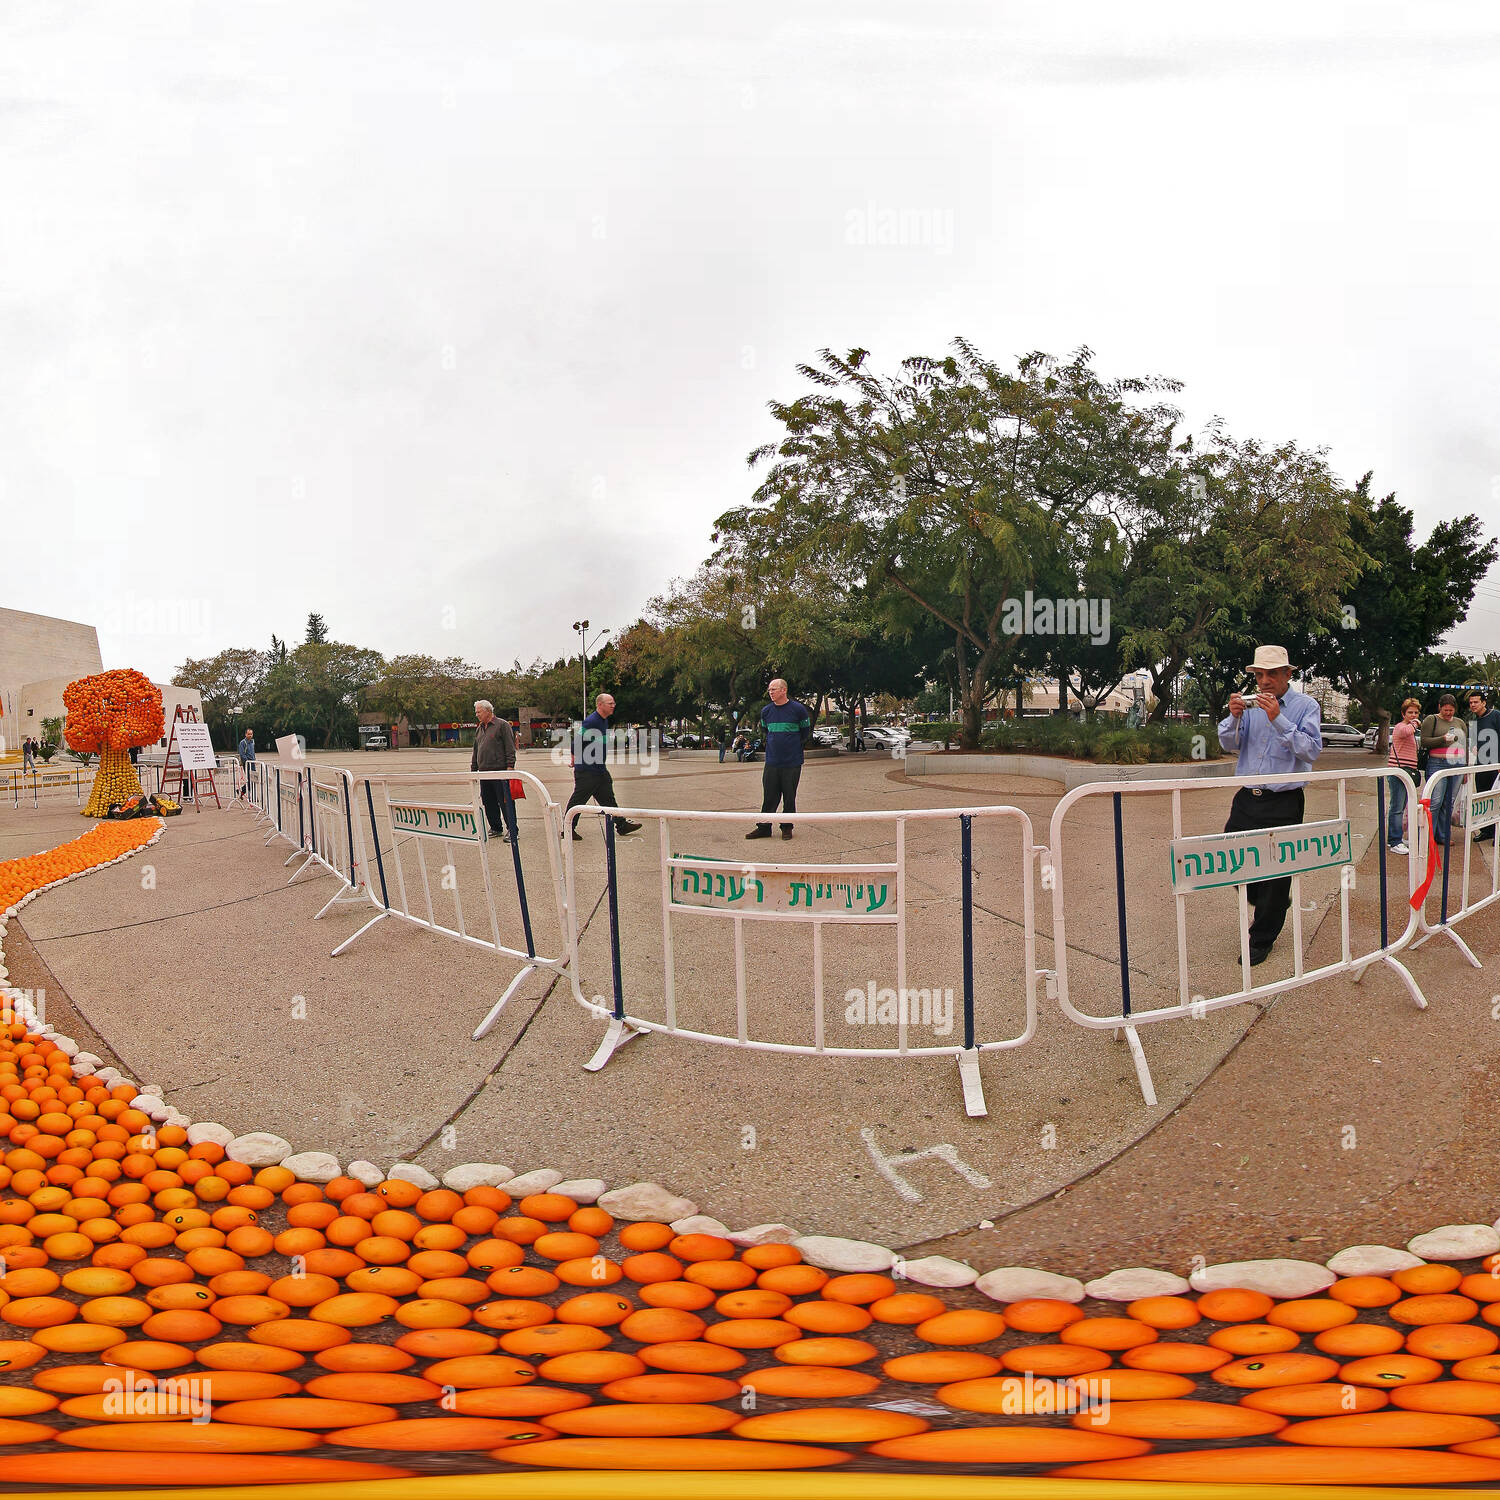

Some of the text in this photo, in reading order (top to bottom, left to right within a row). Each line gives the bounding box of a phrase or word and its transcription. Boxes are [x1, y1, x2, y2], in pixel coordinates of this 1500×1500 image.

[395, 807, 429, 826] רעננה
[1184, 833, 1342, 877] עיריית רעננה
[682, 869, 887, 912] עיריית רעננה
